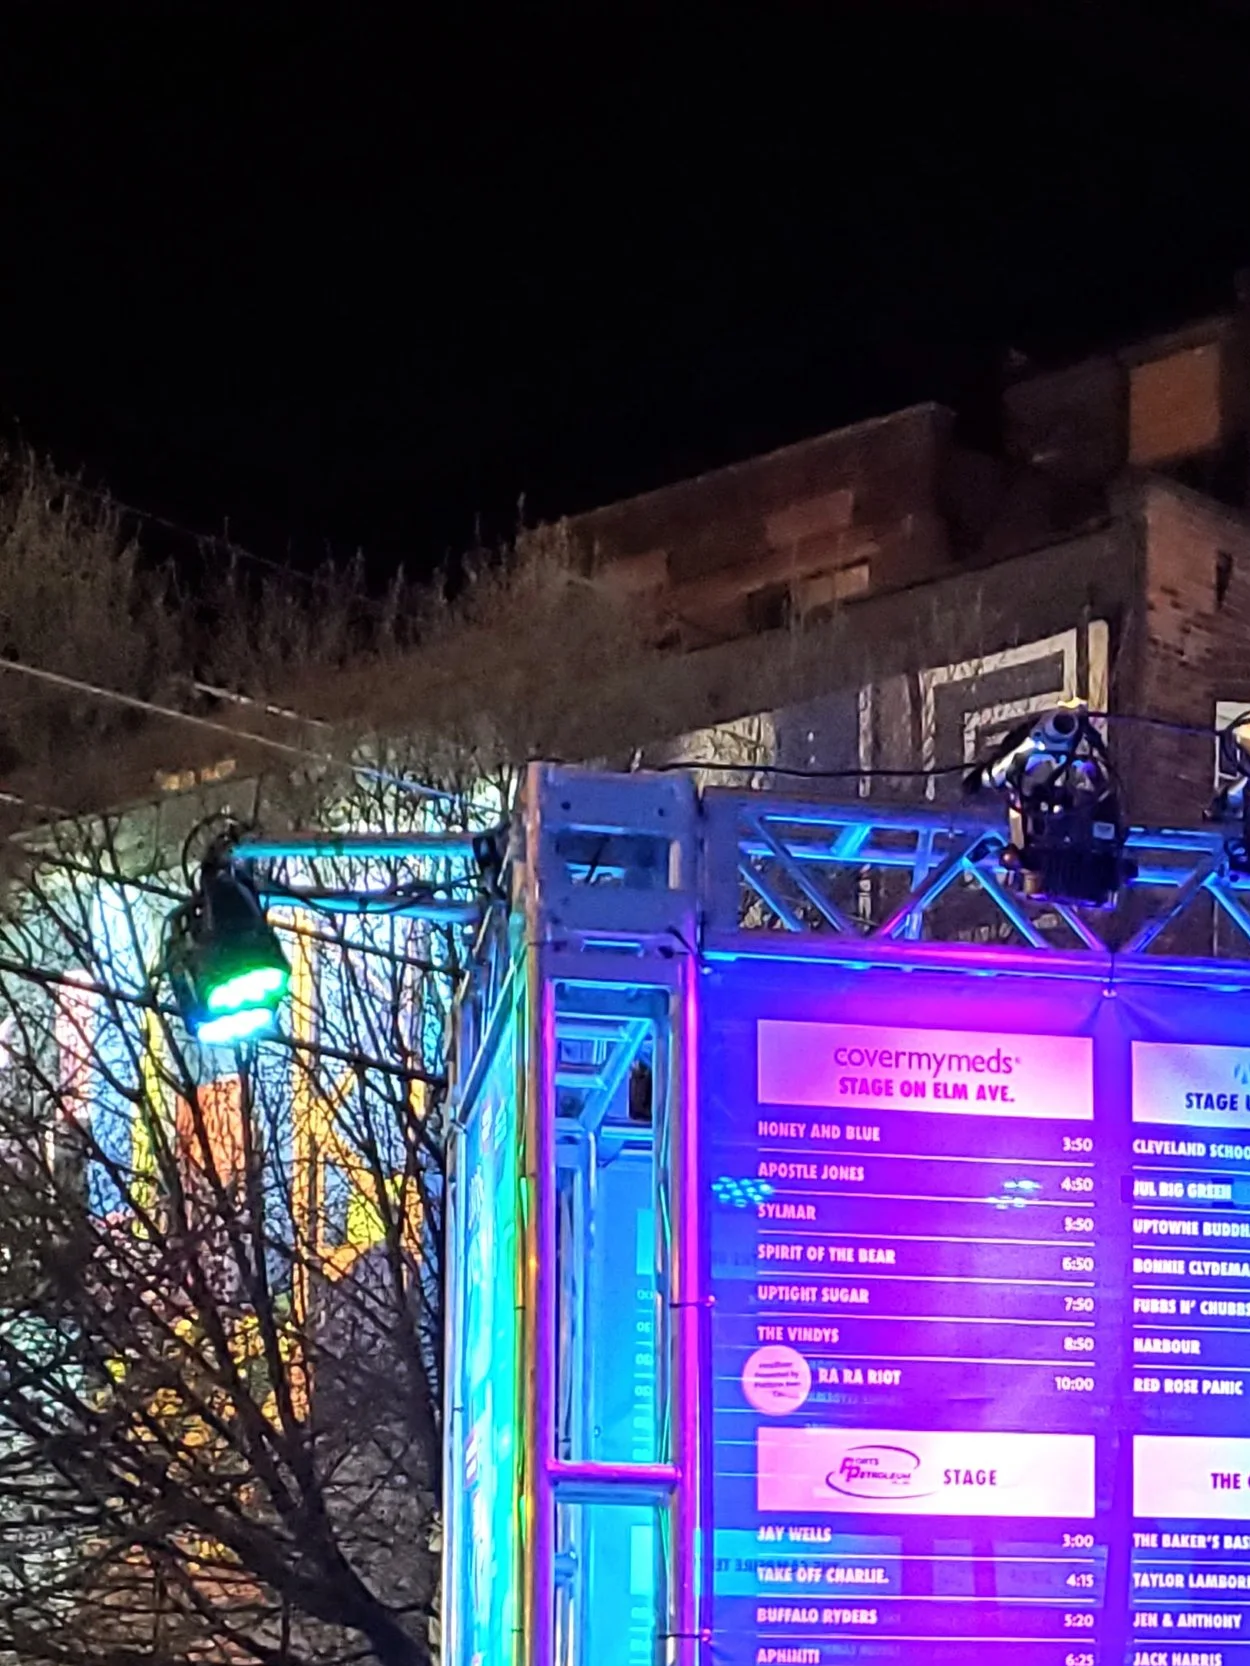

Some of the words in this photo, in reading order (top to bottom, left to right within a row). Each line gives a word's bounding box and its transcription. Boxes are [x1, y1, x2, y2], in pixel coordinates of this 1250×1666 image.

[834, 1048, 1013, 1078] covermymeds
[839, 1077, 894, 1096] STAGE
[900, 1081, 926, 1098] ON
[933, 1082, 968, 1100] ELM
[976, 1084, 1015, 1102] AVE.
[1185, 1093, 1238, 1111] STAGE
[758, 1121, 805, 1138] HONEY
[810, 1123, 840, 1140] AND
[845, 1124, 880, 1141] BLUE
[1062, 1137, 1092, 1152] 3:50
[1133, 1139, 1205, 1157] CLEVELAND
[758, 1163, 817, 1179] APOSTLE
[821, 1164, 864, 1181] JONES
[1061, 1178, 1093, 1192] 4:50
[1159, 1180, 1185, 1199] BIG
[1187, 1182, 1232, 1200] GREEN
[758, 1203, 816, 1221] SYLMAR
[1064, 1218, 1093, 1232] 5:50
[1133, 1219, 1199, 1237] UPTOWNE
[758, 1244, 803, 1260] SPIRIT
[807, 1245, 825, 1261] OF
[829, 1247, 855, 1262] THE
[858, 1248, 895, 1265] BEAR
[1062, 1257, 1093, 1272] 6:50
[1133, 1258, 1185, 1276] BONNIE
[758, 1285, 818, 1302] UPTIGHT
[821, 1287, 869, 1304] SUGAR
[1064, 1297, 1093, 1312] 7:50
[758, 1326, 785, 1341] THE
[788, 1326, 839, 1343] VINDYS
[1064, 1337, 1093, 1352] 8:50
[1133, 1338, 1200, 1355] HARBOUR
[819, 1368, 839, 1382] RA
[843, 1369, 864, 1383] RA
[868, 1370, 901, 1385] RIOT
[1055, 1377, 1094, 1391] 10:00
[1134, 1377, 1161, 1393] RED
[1164, 1378, 1198, 1395] ROSE
[1202, 1379, 1243, 1396] PANIC
[944, 1469, 997, 1485] STAGE
[1211, 1473, 1241, 1490] THE
[757, 1527, 785, 1542] JAY
[788, 1527, 832, 1542] WELLS
[1062, 1534, 1093, 1548] 3:00
[1133, 1534, 1157, 1548] THE
[1161, 1534, 1220, 1549] BAKER'S
[757, 1567, 792, 1583] TAKE
[797, 1569, 823, 1583] OFF
[826, 1569, 889, 1585] CHARLIE.
[1066, 1574, 1093, 1588] 4:15
[1133, 1574, 1185, 1589] TAYLOR
[757, 1609, 818, 1623] BUFFALO
[823, 1609, 878, 1625] RYDERS
[1064, 1614, 1094, 1628] 5:20
[1133, 1614, 1158, 1629] JEN
[1162, 1614, 1173, 1628] &
[1177, 1614, 1241, 1630] ANTHONY
[1065, 1654, 1094, 1666] 6:25
[1133, 1653, 1168, 1666] JACK
